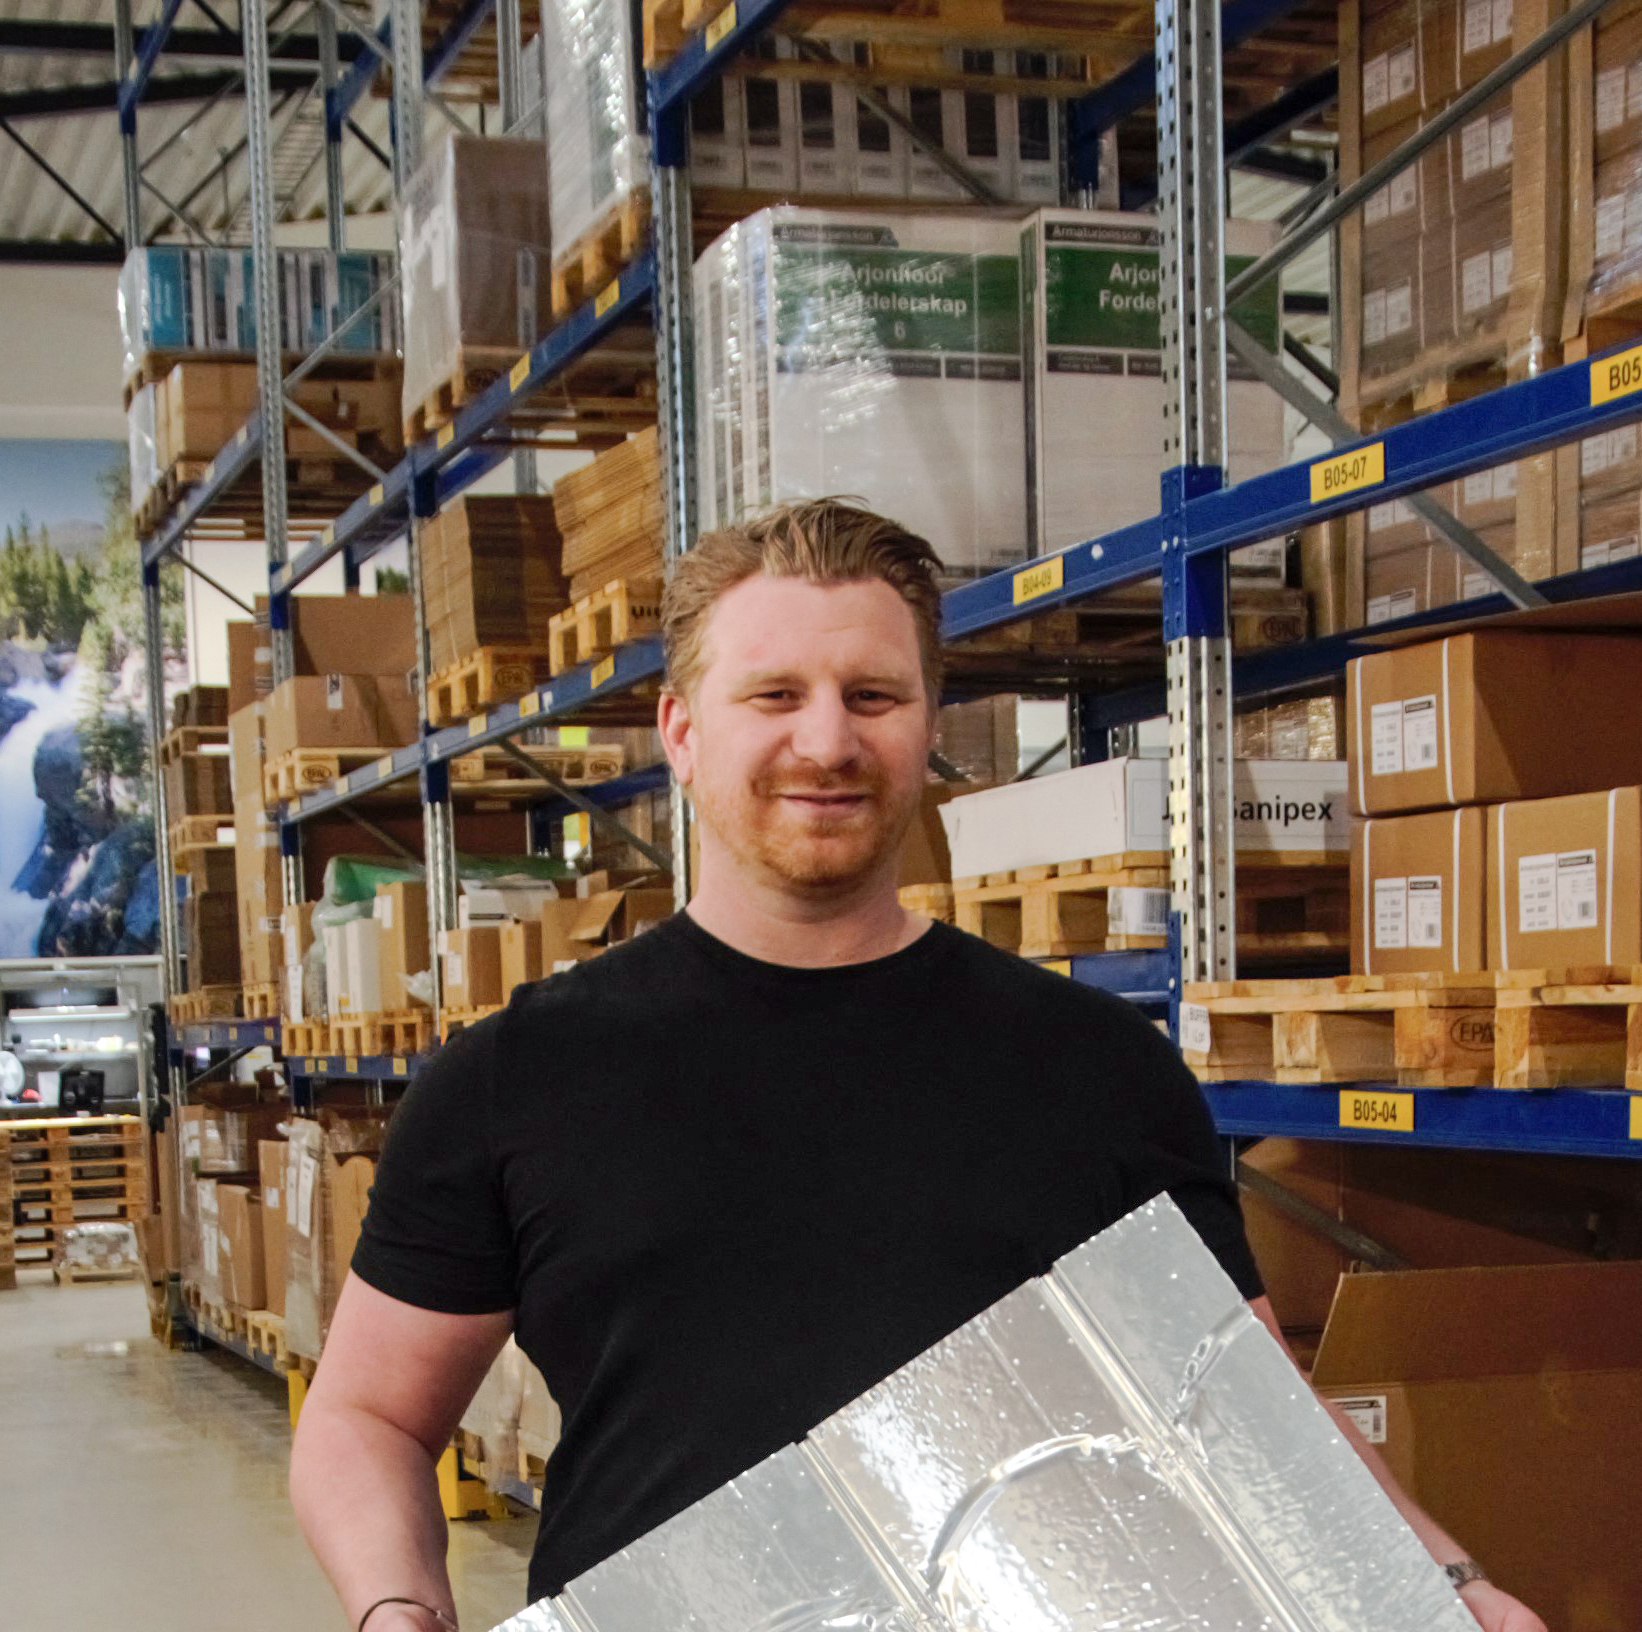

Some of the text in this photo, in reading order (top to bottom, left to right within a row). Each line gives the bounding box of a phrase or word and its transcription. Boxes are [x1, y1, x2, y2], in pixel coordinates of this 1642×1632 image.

[830, 290, 967, 317] Fdelerskap
[1099, 290, 1160, 310] Forde
[1323, 455, 1367, 490] B05-07
[1232, 795, 1334, 827] anipex
[1459, 1022, 1495, 1042] EPA
[1353, 1100, 1397, 1124] B05-04
